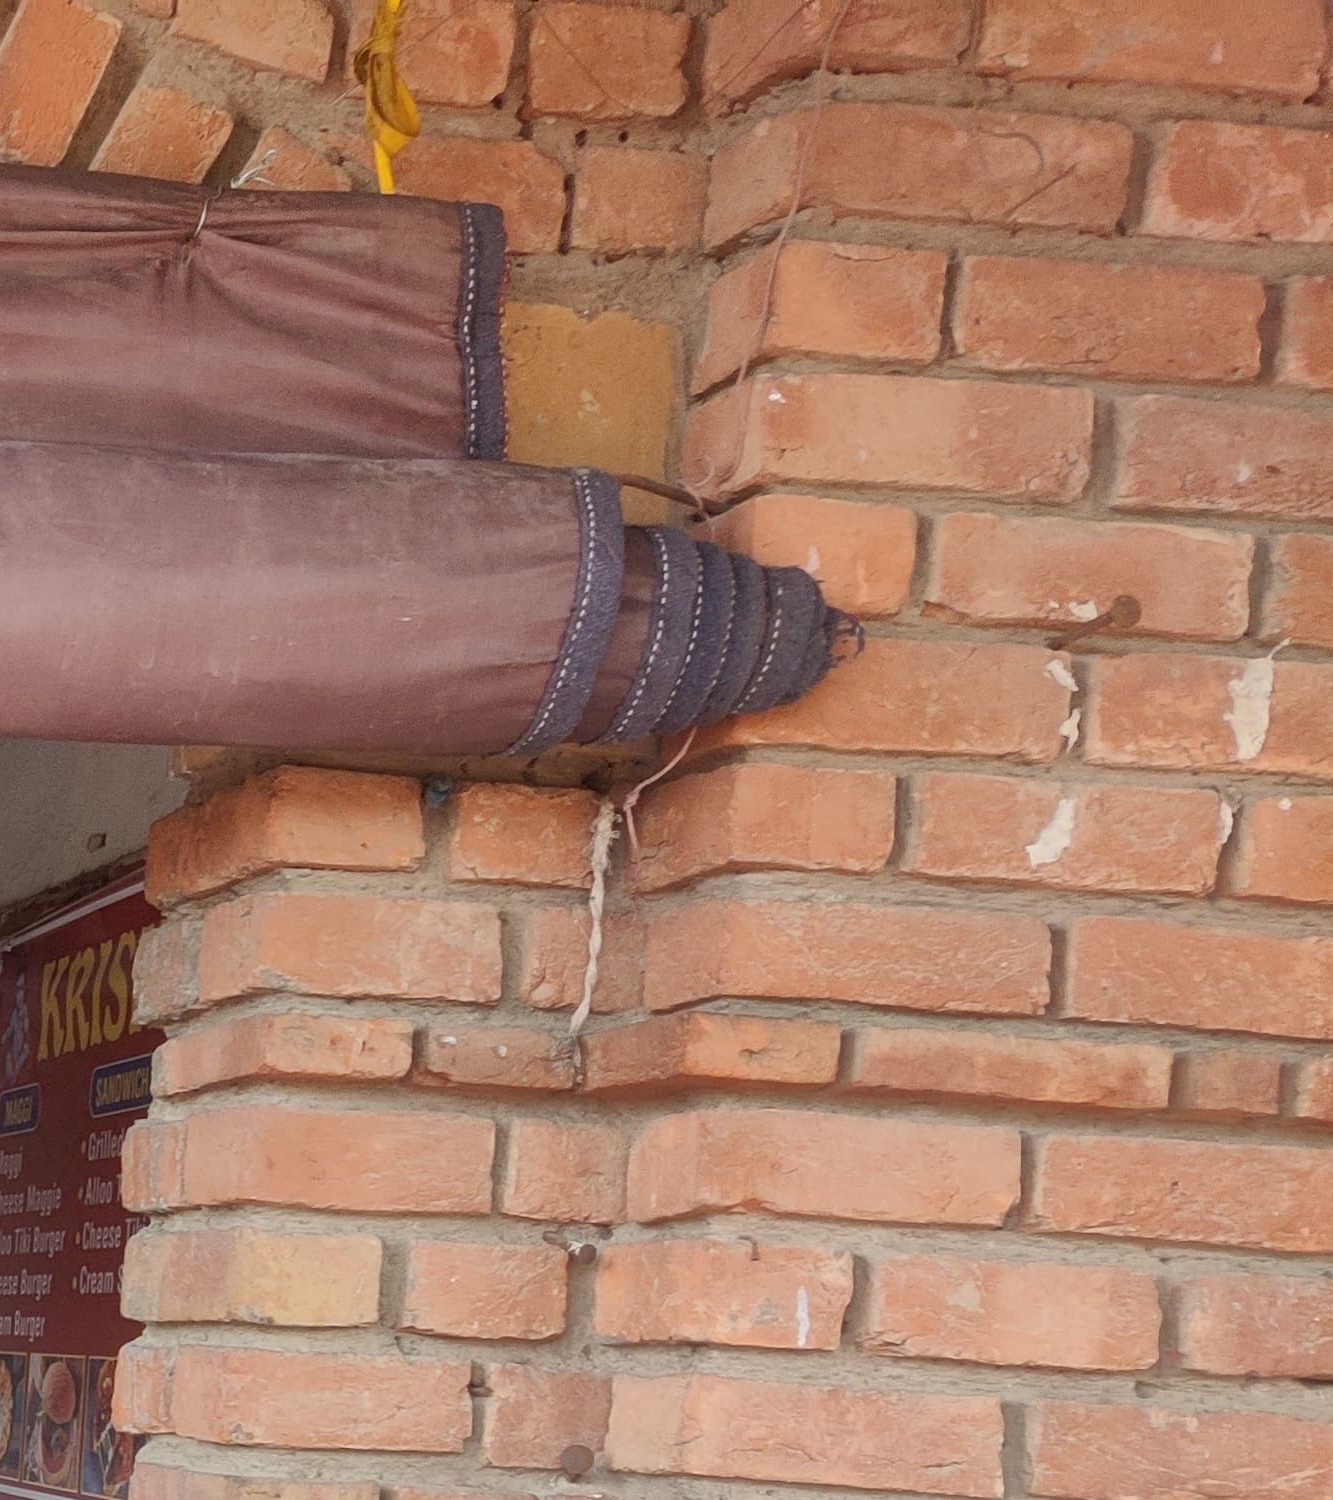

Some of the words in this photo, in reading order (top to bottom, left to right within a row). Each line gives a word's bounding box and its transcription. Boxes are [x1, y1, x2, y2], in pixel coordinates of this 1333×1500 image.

[37, 930, 141, 1061] KRIS
[87, 1129, 125, 1162] Grilled
[26, 1181, 62, 1216] Maggie
[84, 1176, 114, 1206] Alloo
[32, 1228, 66, 1258] Burger
[81, 1225, 122, 1251] Cheese
[20, 1269, 53, 1301] Burger
[78, 1265, 114, 1295] Cream
[14, 1309, 46, 1343] Burger
